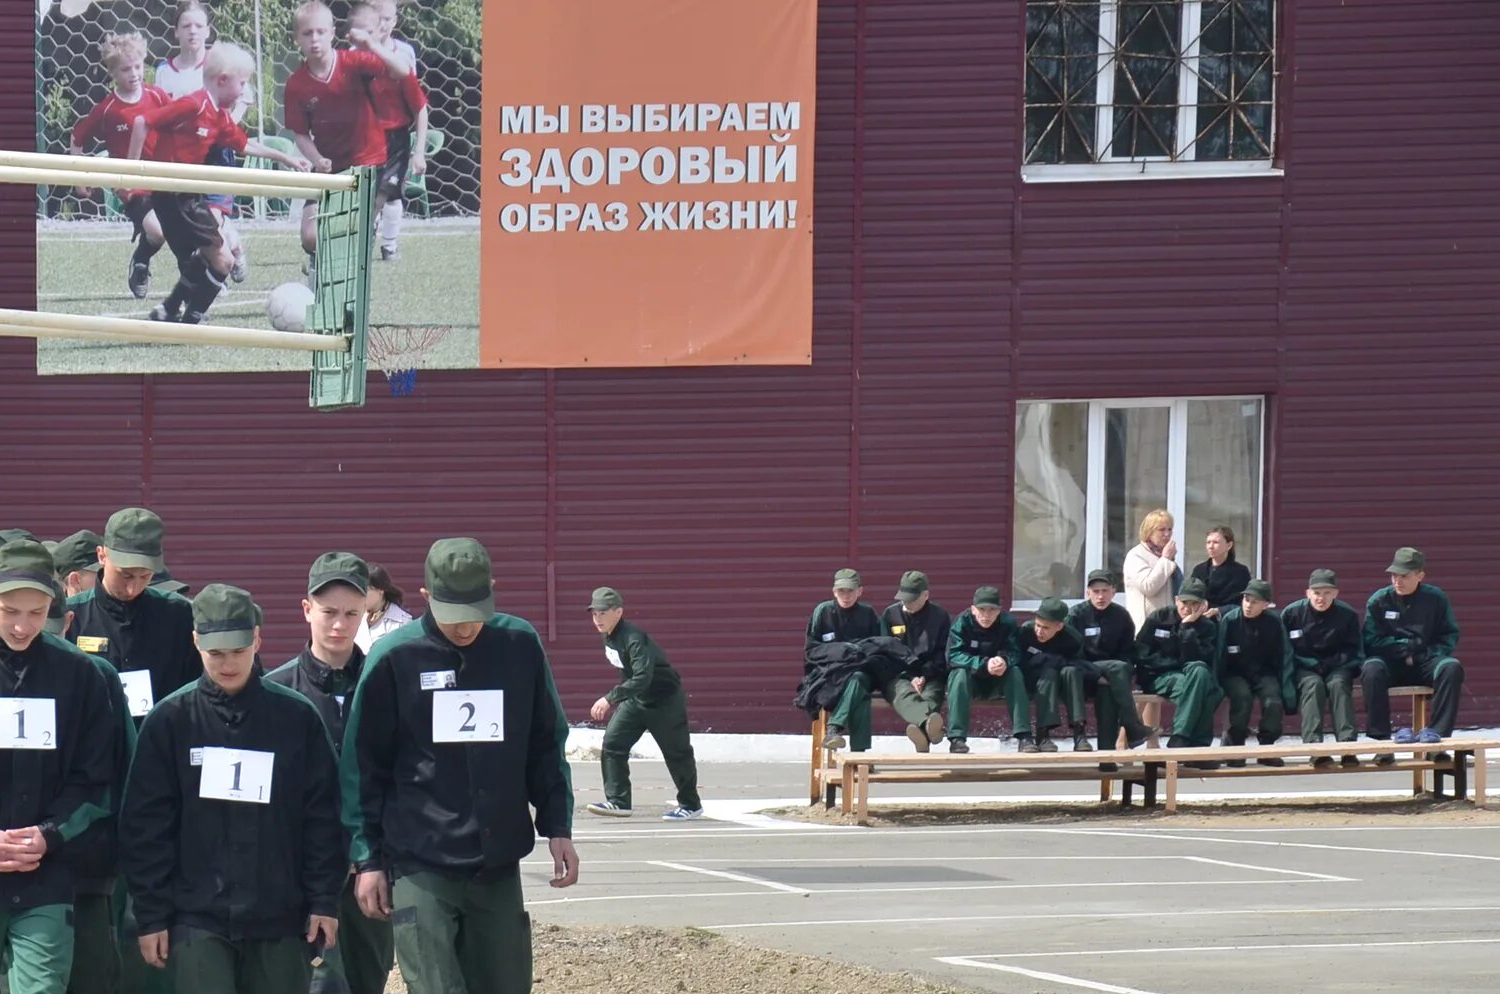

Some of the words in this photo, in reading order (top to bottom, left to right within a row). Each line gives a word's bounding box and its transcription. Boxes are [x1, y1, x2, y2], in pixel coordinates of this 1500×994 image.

[500, 105, 570, 134] МЫ
[580, 102, 800, 133] ВЫБИРАЕМ
[499, 133, 797, 194] ЗДОРОВЫЙ
[499, 202, 629, 233] ОБРАЗ
[638, 200, 798, 231] ЖИЗНИ!
[140, 698, 149, 712] 2
[458, 701, 476, 732] 2
[490, 722, 500, 738] 2
[13, 709, 28, 739] 1
[42, 730, 52, 746] 2
[228, 761, 244, 792] 1
